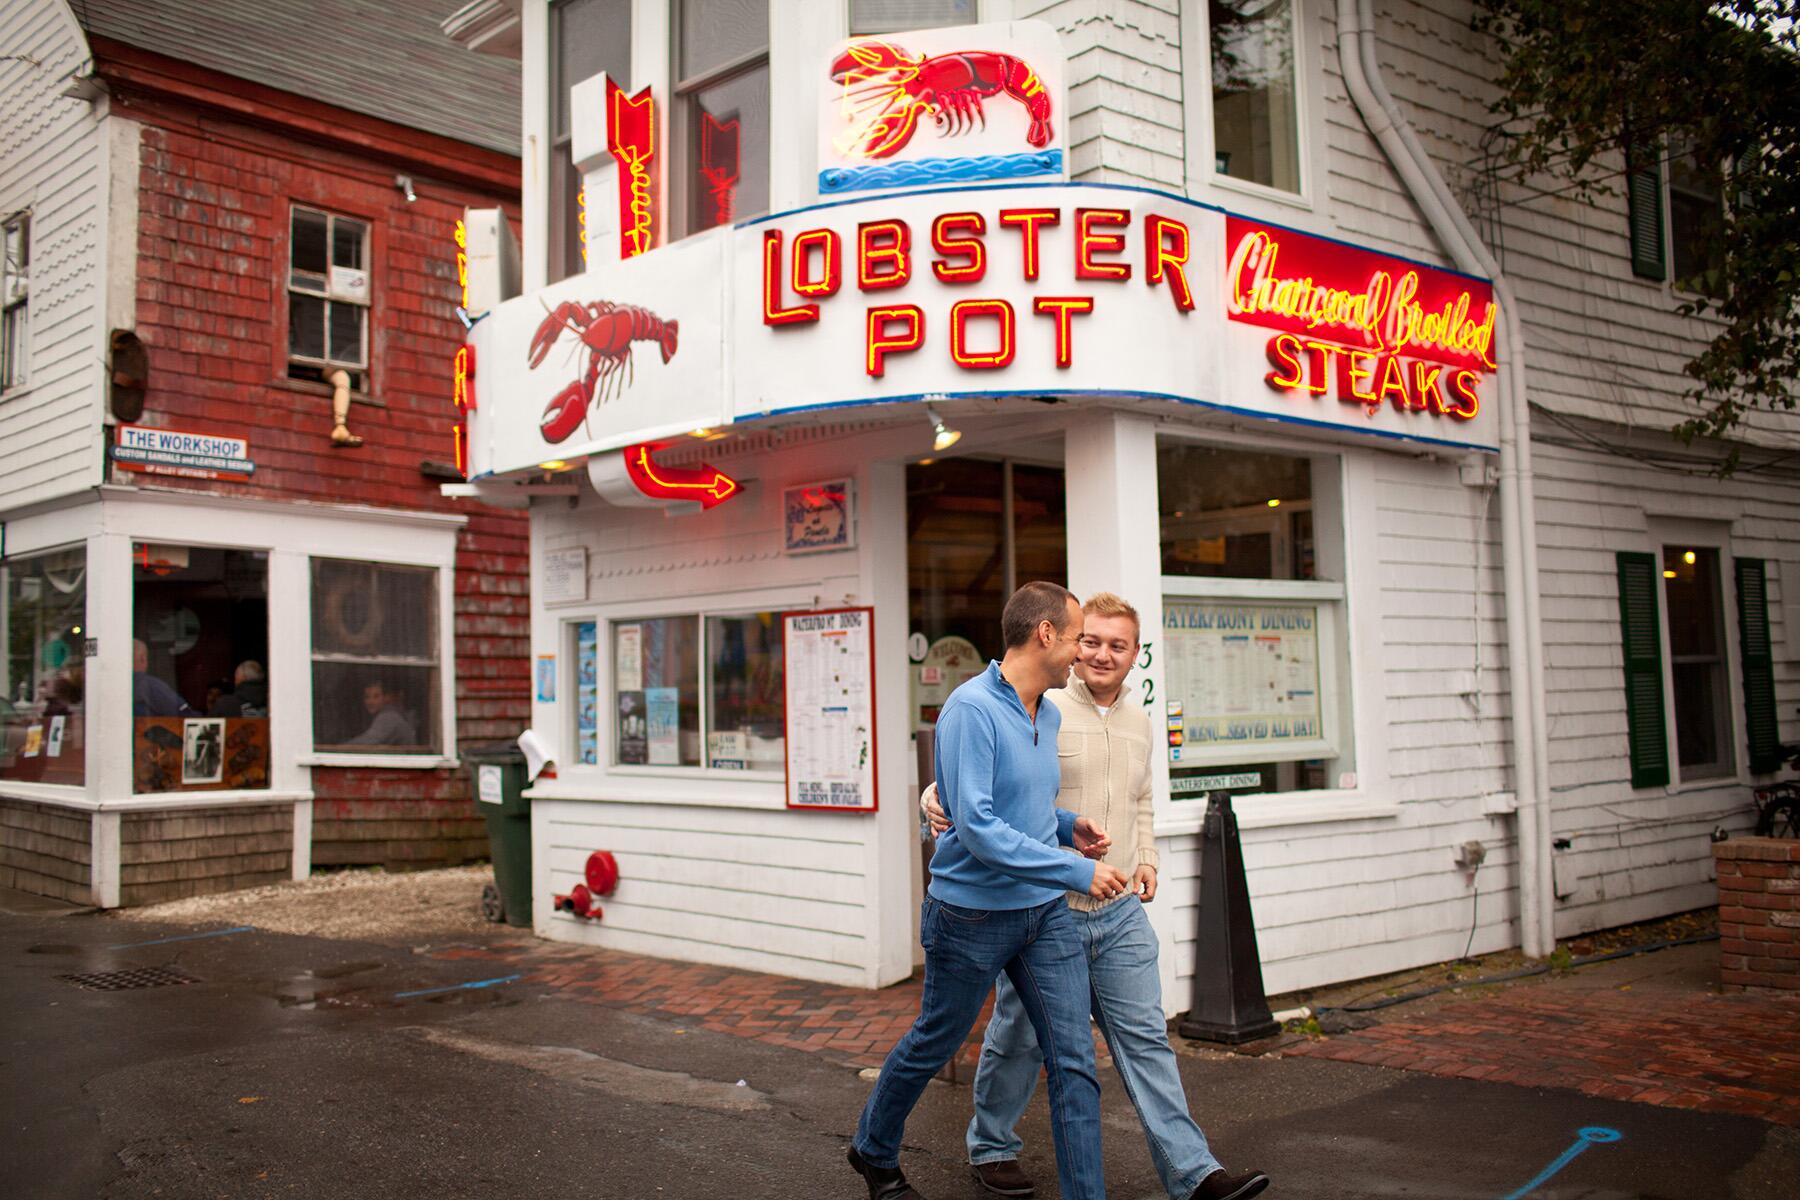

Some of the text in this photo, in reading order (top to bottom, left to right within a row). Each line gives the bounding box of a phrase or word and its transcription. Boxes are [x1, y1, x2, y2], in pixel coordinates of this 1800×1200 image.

[763, 208, 1195, 326] LOBSTER
[1227, 231, 1497, 368] Charcoal Broiled
[866, 297, 1093, 377] POT
[1264, 334, 1479, 420] STEAKS
[126, 430, 240, 456] THE WORKSHOP
[1261, 609, 1312, 630] DINING
[1272, 721, 1290, 738] ALL
[1171, 774, 1259, 791] WATERFRONT DINING
